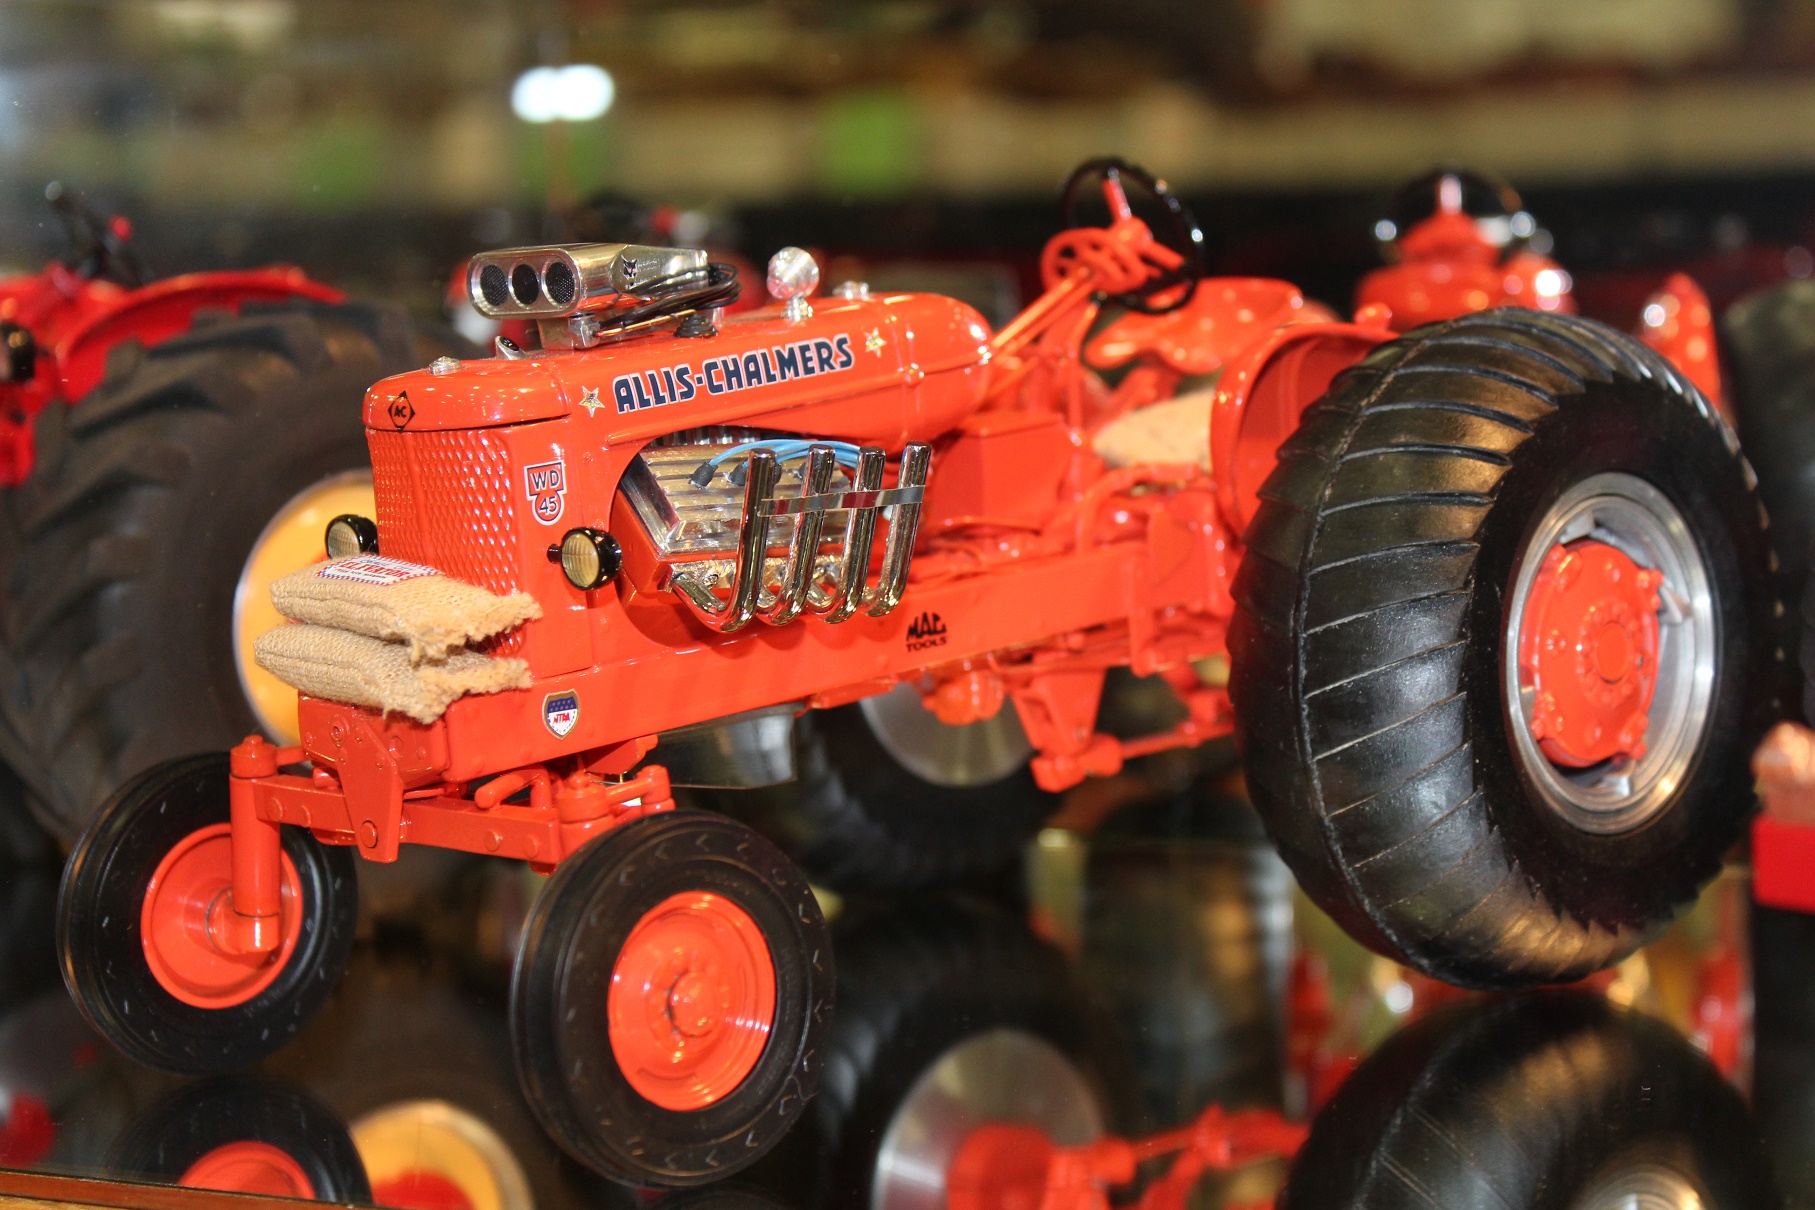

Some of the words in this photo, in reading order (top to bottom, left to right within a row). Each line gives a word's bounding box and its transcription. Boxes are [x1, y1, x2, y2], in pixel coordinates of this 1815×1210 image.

[613, 334, 854, 413] ALLIS-CHALMERS
[394, 405, 406, 418] AC
[531, 469, 560, 491] WD
[539, 496, 558, 515] 45
[906, 611, 947, 641] MAC
[906, 637, 947, 652] TOOLS
